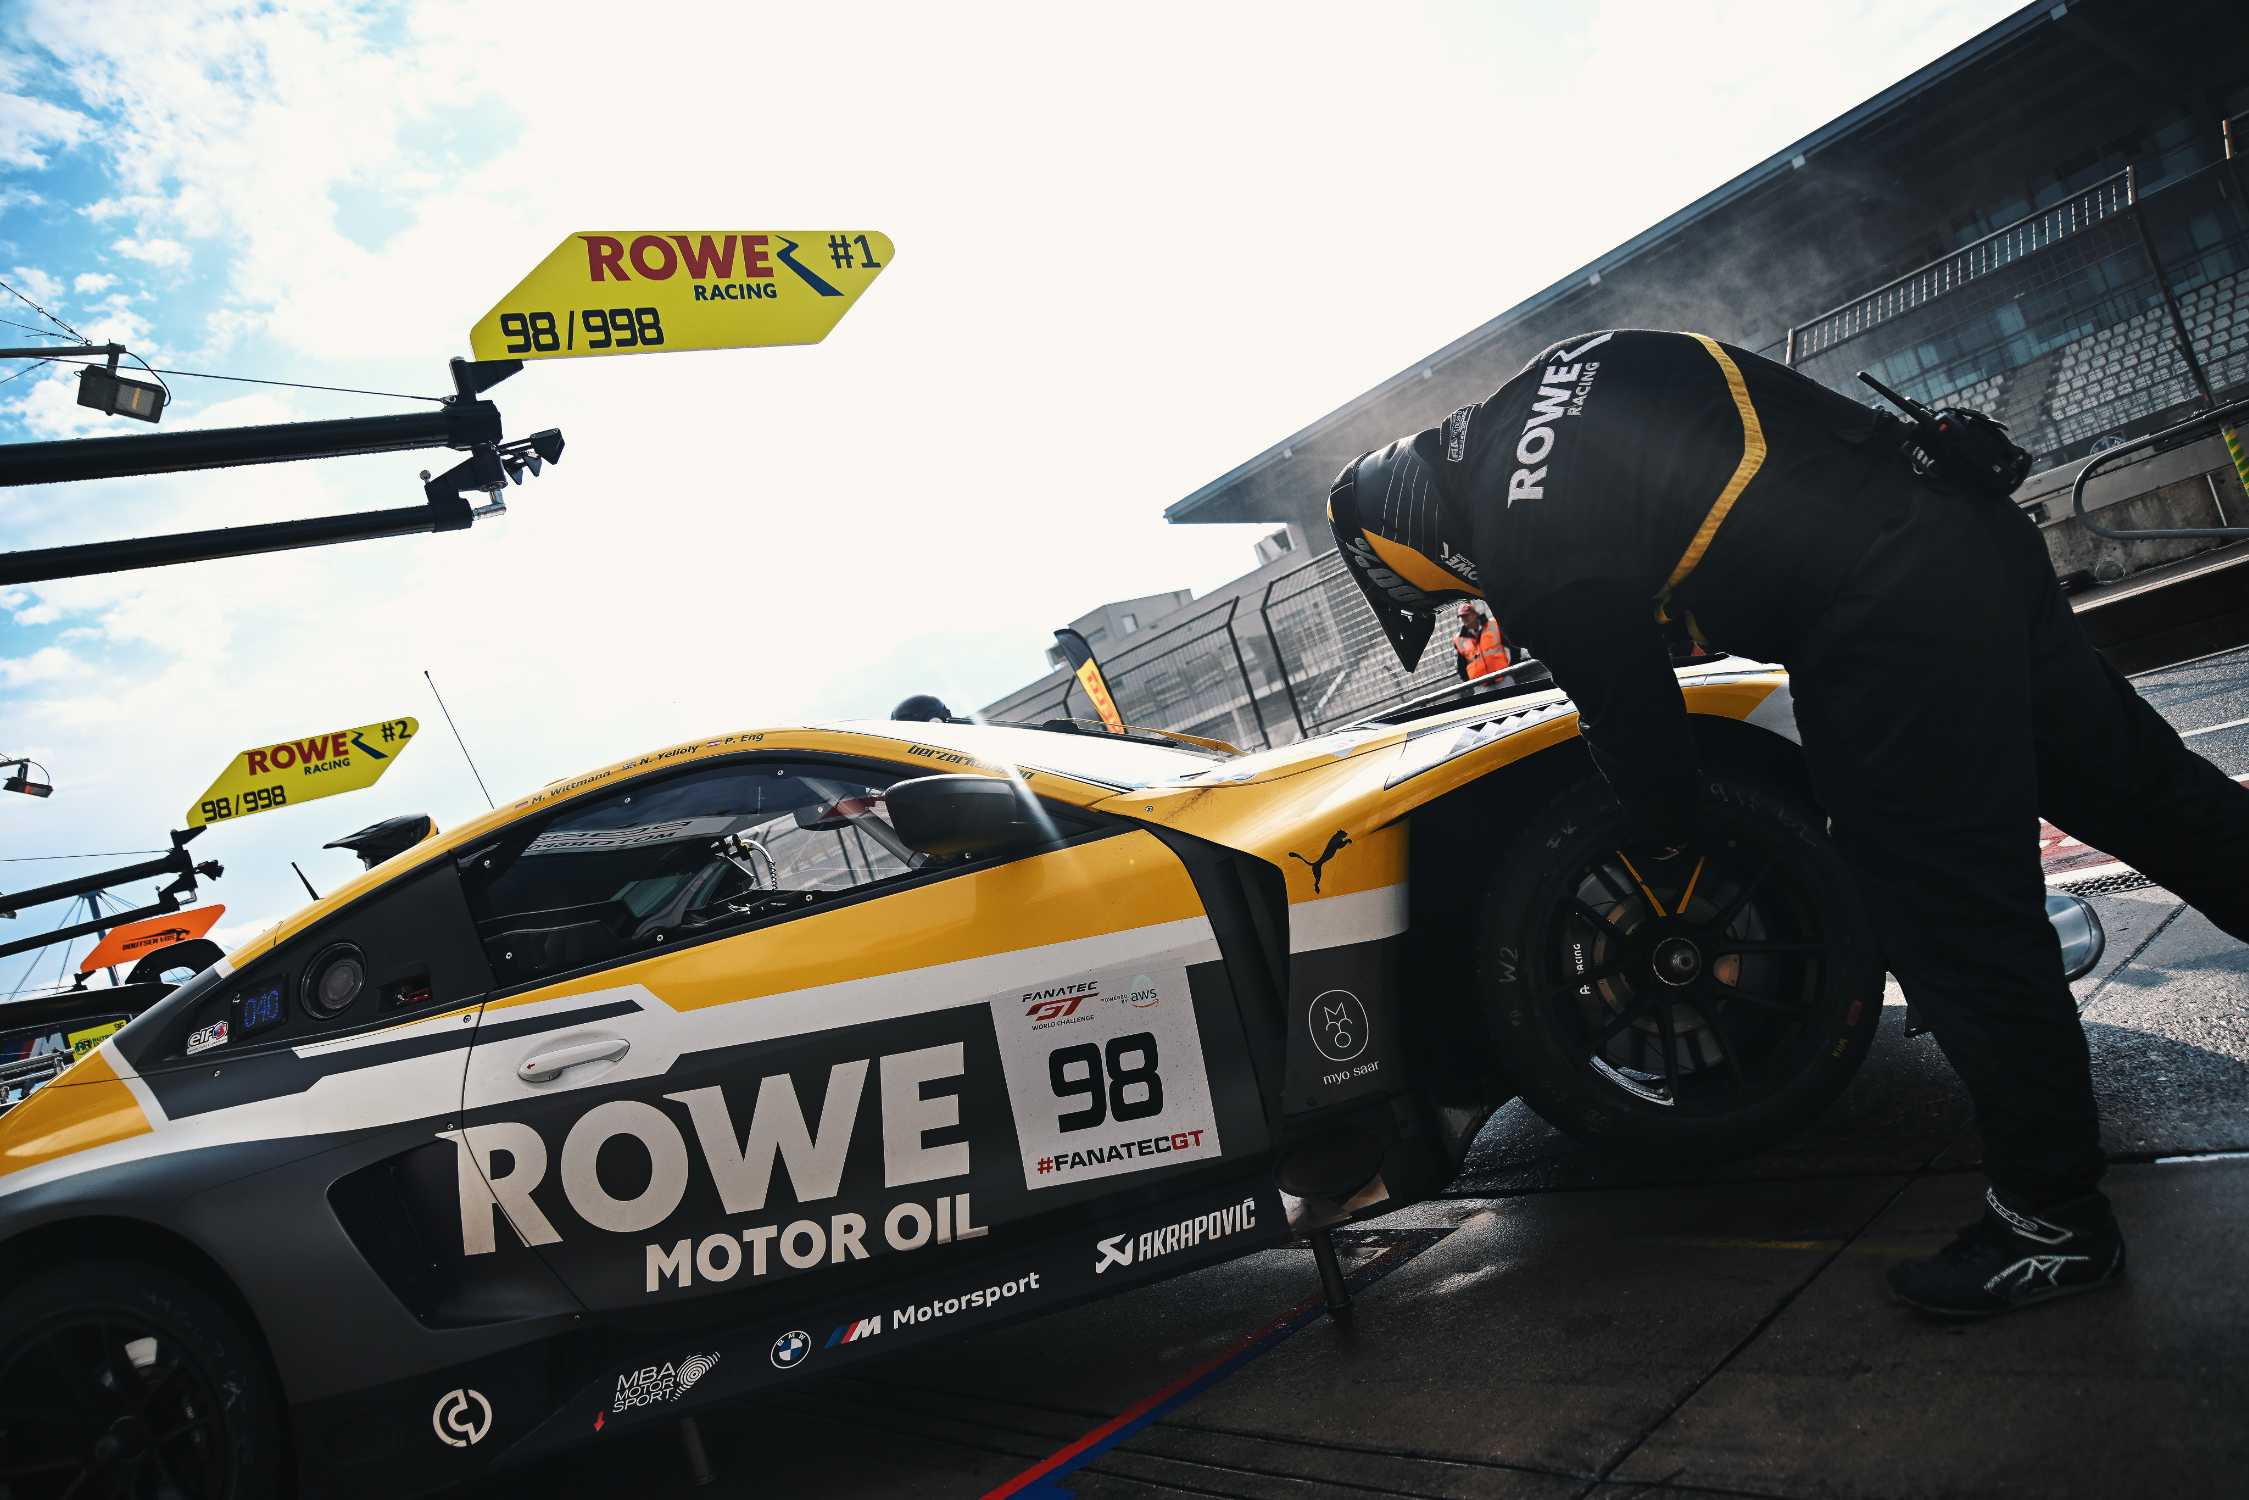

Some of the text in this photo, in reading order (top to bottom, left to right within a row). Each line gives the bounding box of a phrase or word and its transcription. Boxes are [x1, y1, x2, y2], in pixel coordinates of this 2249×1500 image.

[578, 234, 881, 282] ROWE #1
[693, 283, 777, 301] RACING
[500, 307, 664, 353] 98/998
[1567, 361, 1600, 416] RACING
[1508, 362, 1583, 509] ROWE
[1446, 556, 1479, 581] OWE
[241, 720, 412, 776] ROWE #2
[740, 733, 764, 743] Eng
[304, 757, 350, 776] RACING
[201, 785, 287, 822] 98/998
[1022, 981, 1098, 1002] FANATEC
[1025, 992, 1100, 1022] GT
[1131, 988, 1157, 1002] aws
[1032, 1014, 1095, 1031] WORLD CHALLENGE
[1049, 1031, 1164, 1134] 98
[1323, 1060, 1381, 1086] myo saar
[434, 1041, 970, 1256] ROWE
[1038, 1130, 1204, 1175] #FANATECGT
[646, 1193, 989, 1293] MOTOR OIL
[1139, 1198, 1255, 1262] AKRAPOVIČ
[893, 1271, 1040, 1330] Motorsport
[615, 1377, 675, 1402] MOTOR
[616, 1362, 676, 1391] MBA
[612, 1387, 675, 1413] SPORT
